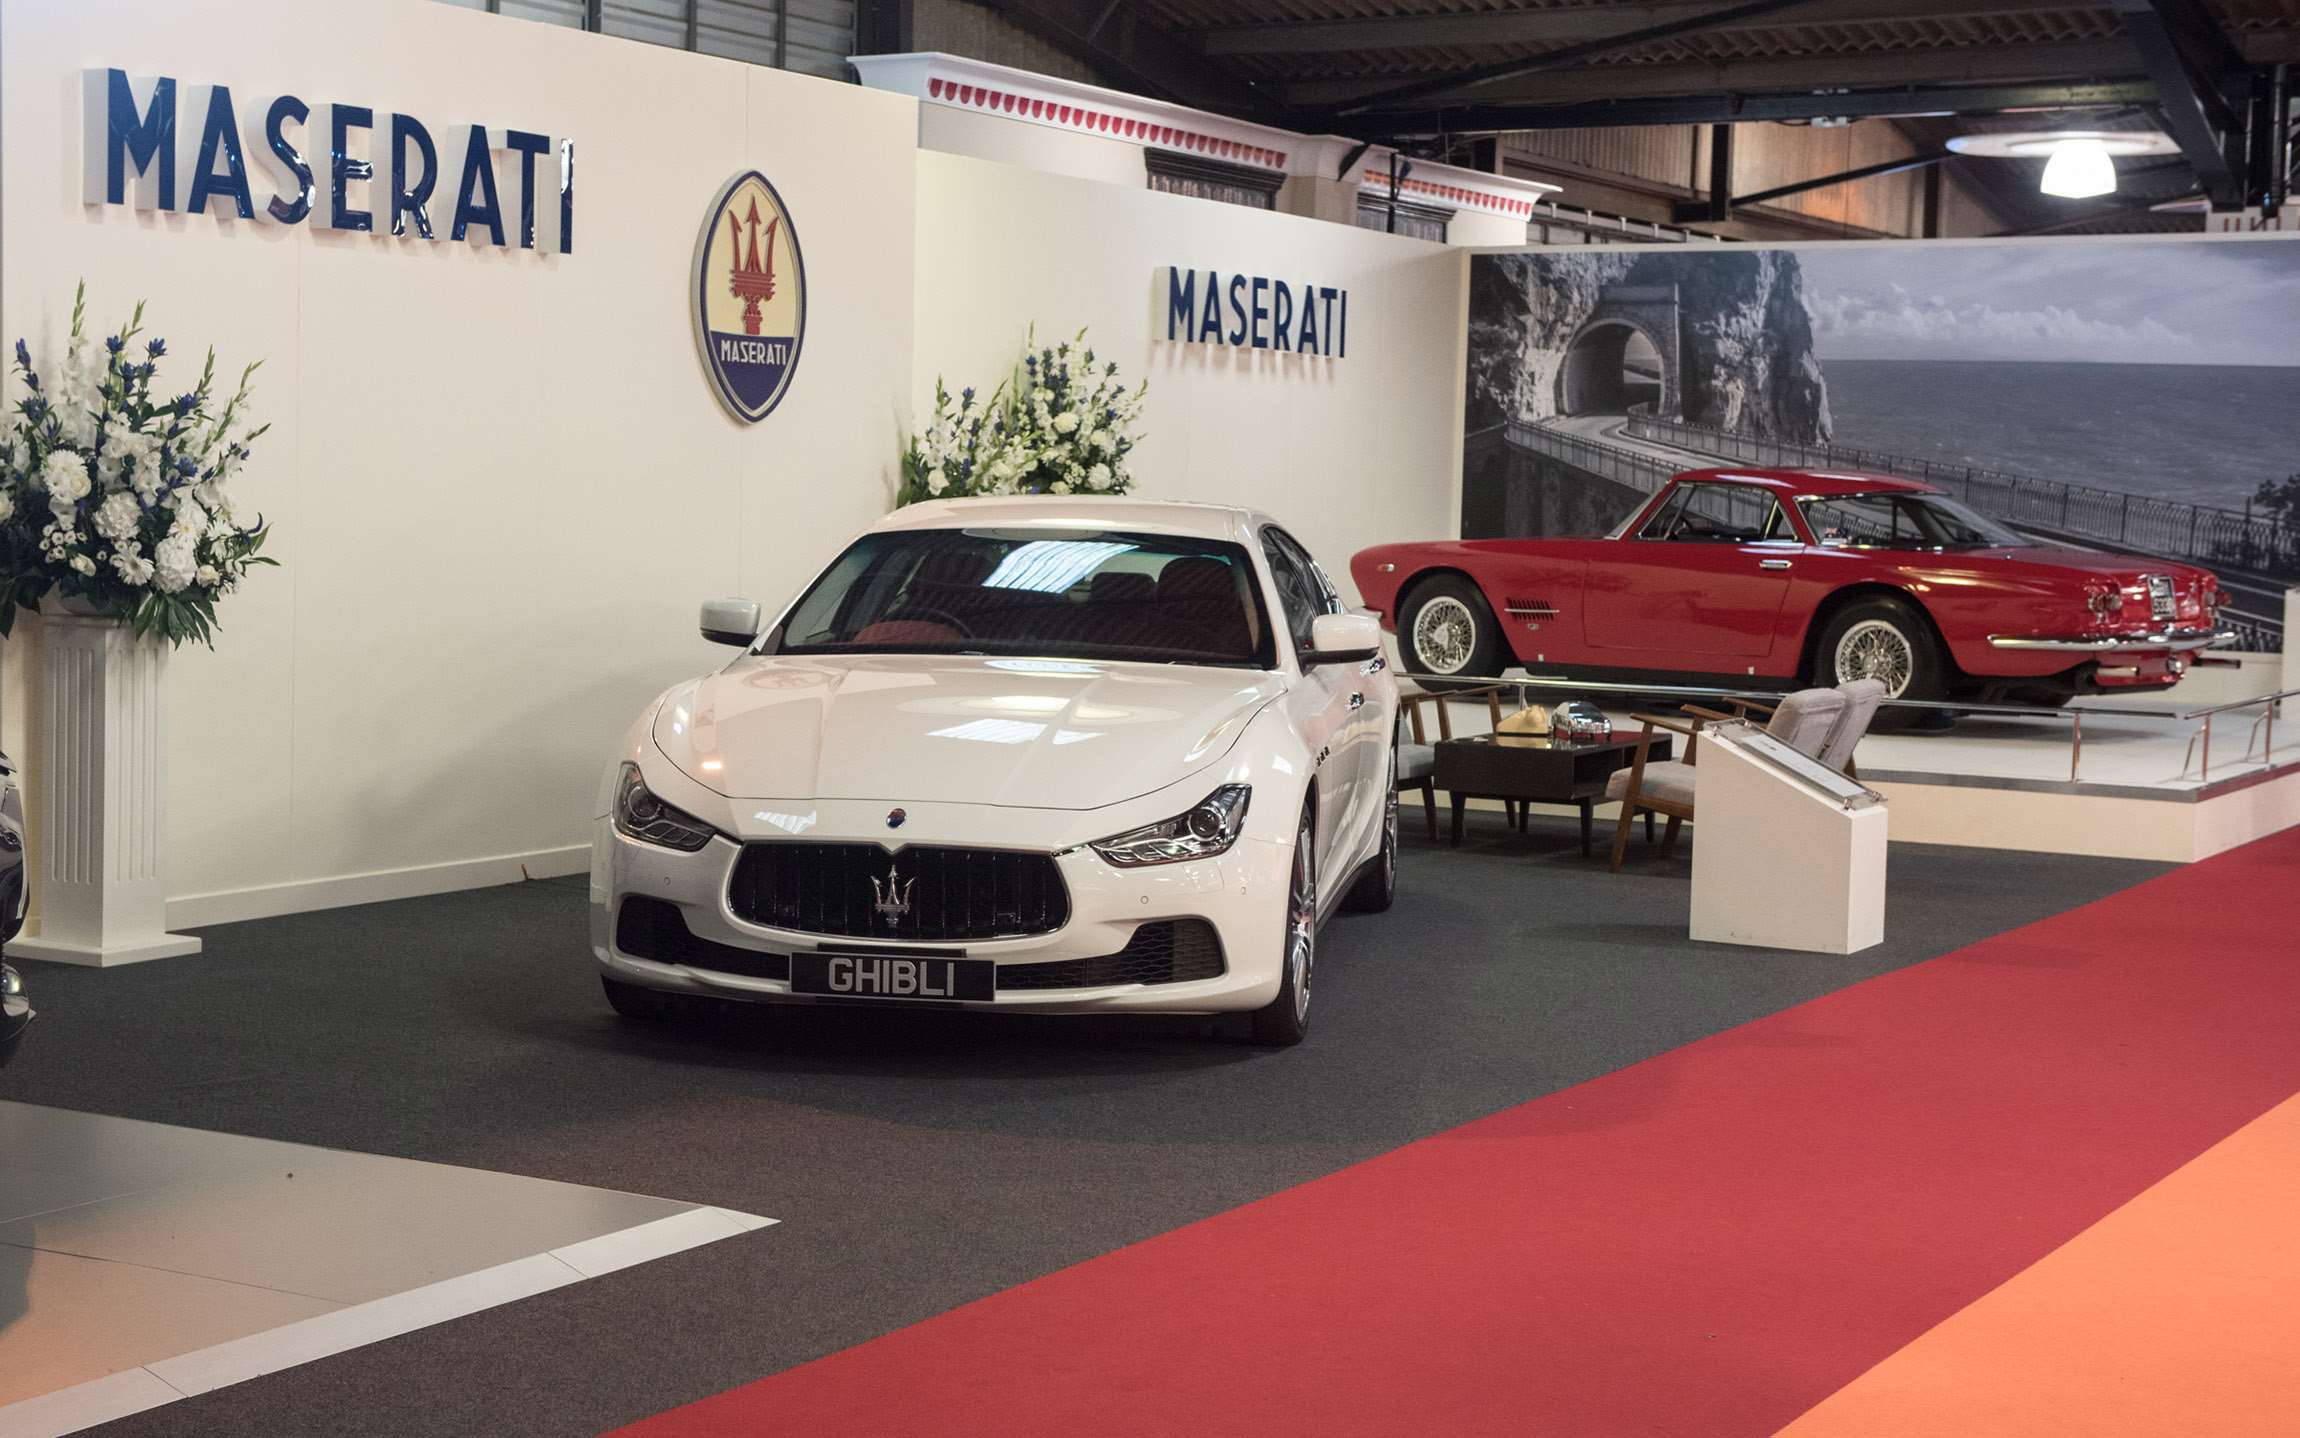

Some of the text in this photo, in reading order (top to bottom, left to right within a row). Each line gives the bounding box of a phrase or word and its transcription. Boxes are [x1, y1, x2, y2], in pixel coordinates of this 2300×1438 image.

[106, 67, 574, 254] MASERATI
[1168, 266, 1347, 358] MASERATI
[721, 339, 787, 366] MASERATI
[828, 957, 955, 997] GHIBLI
